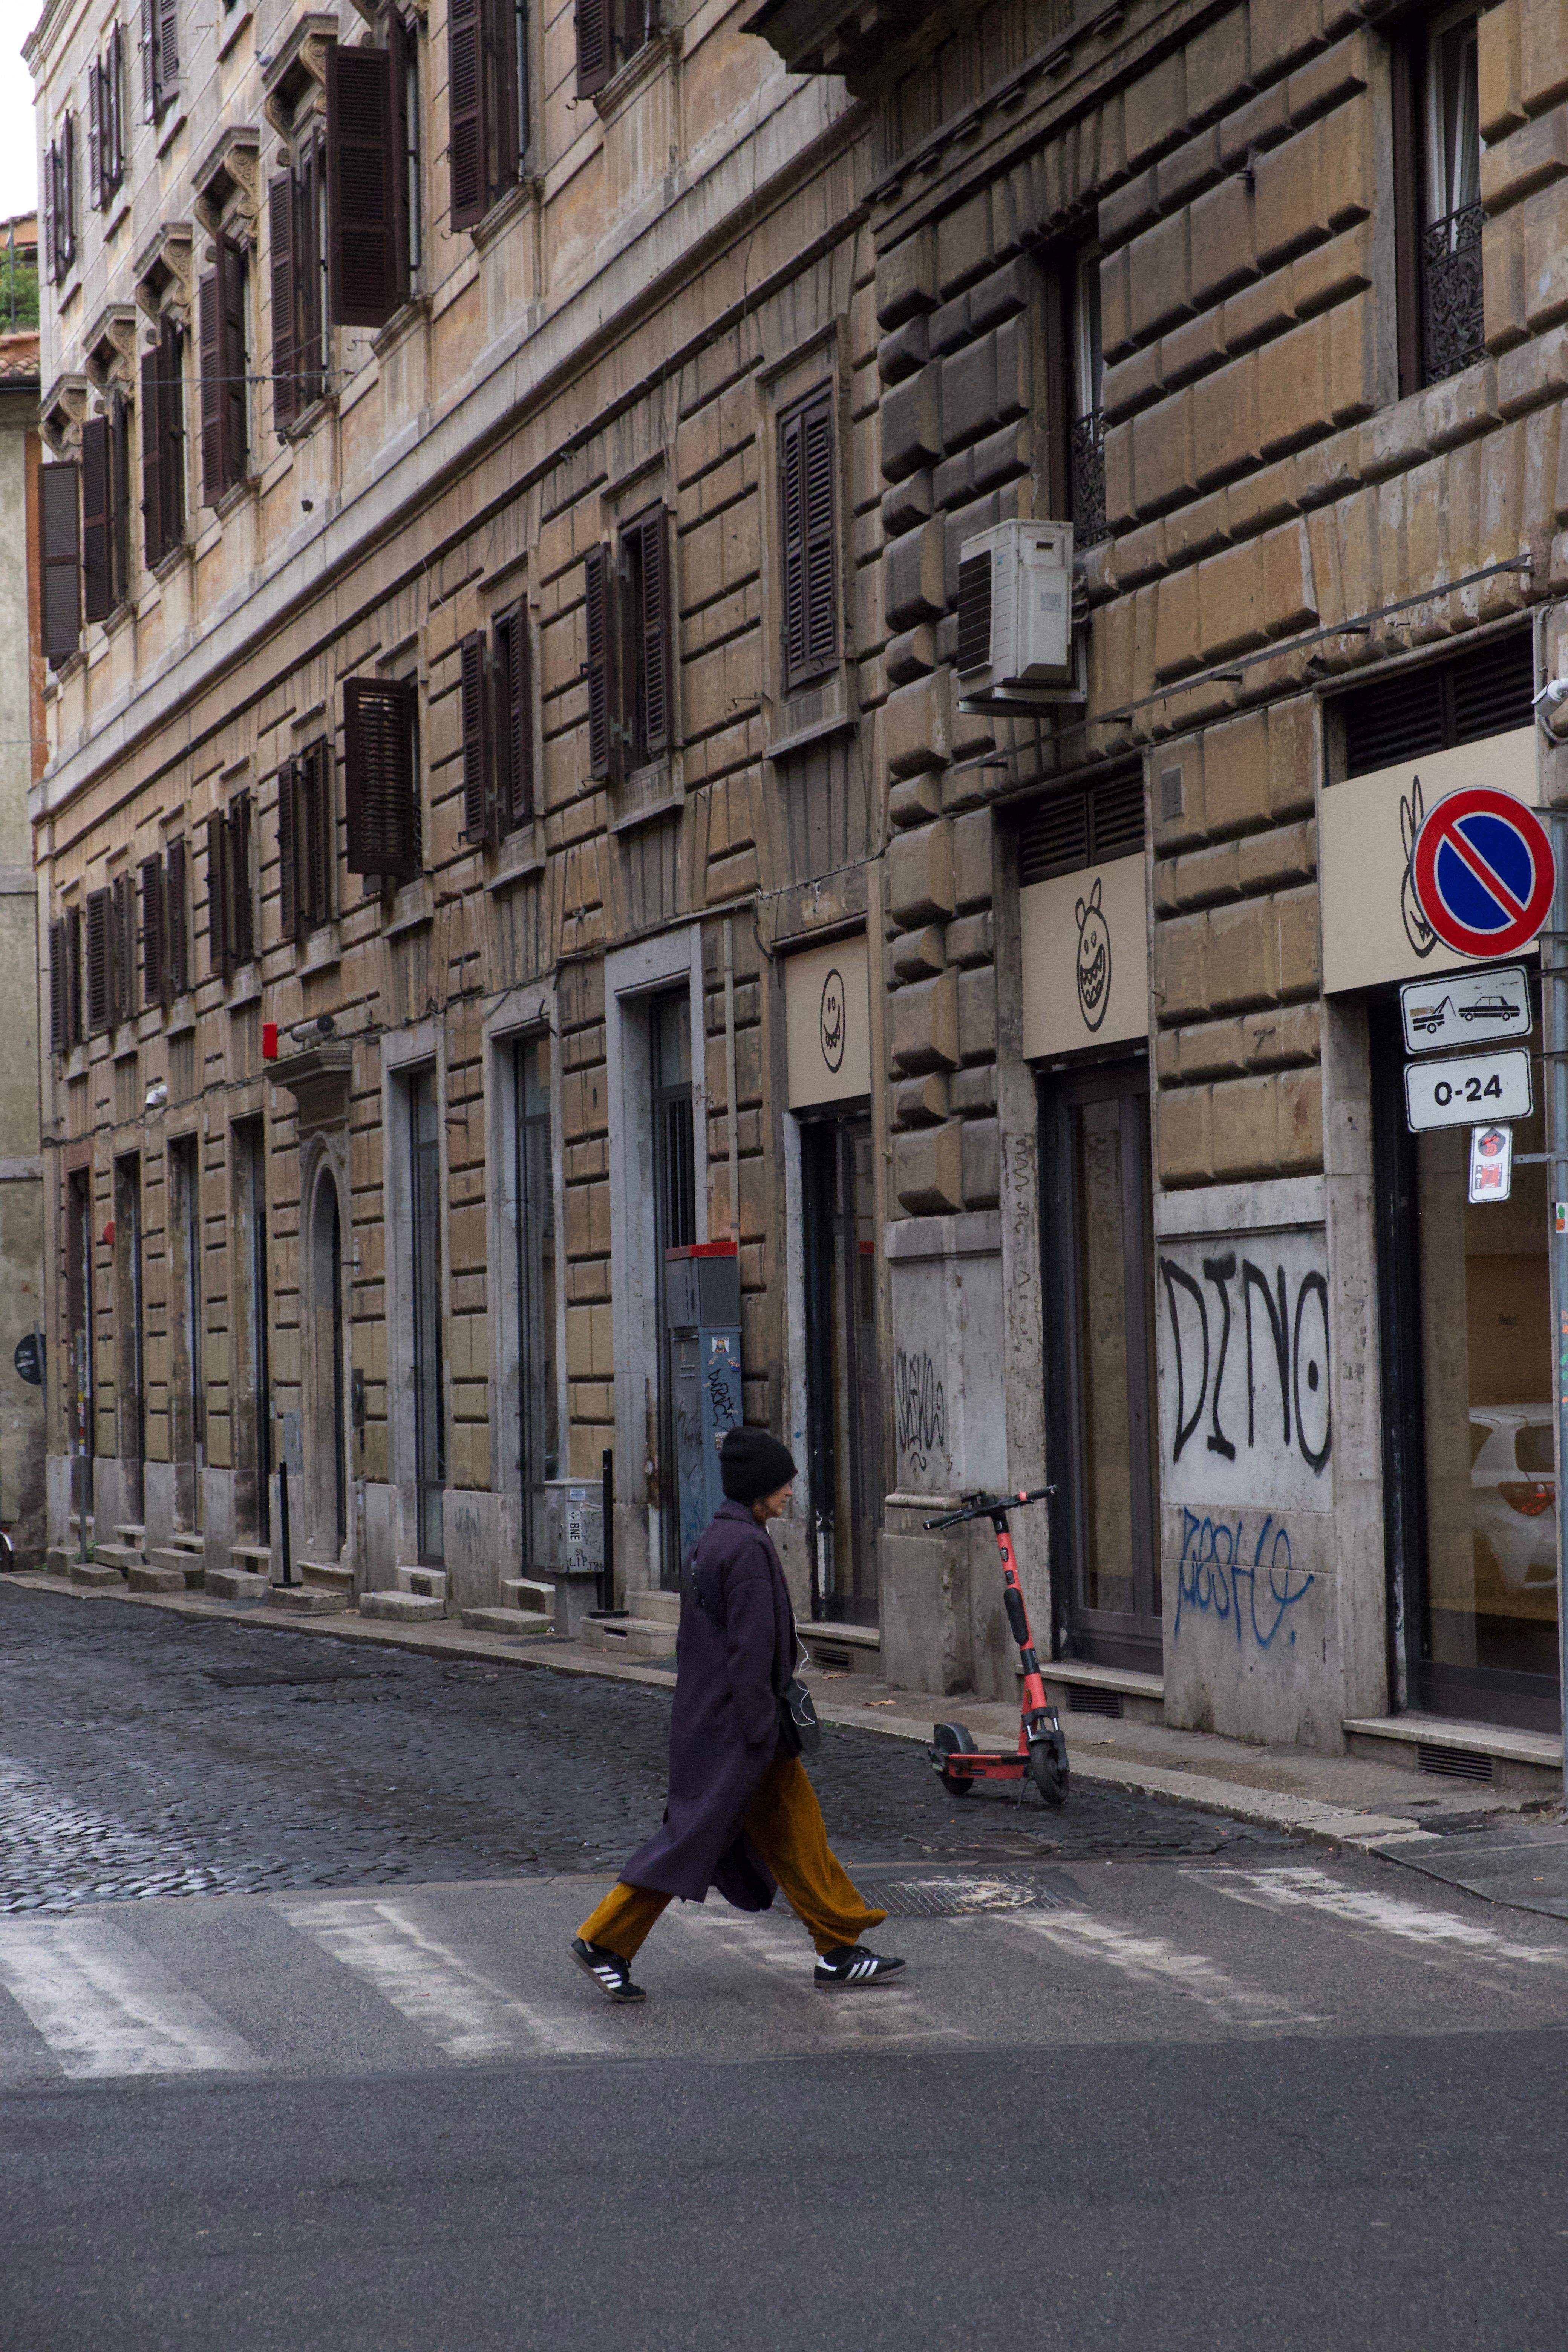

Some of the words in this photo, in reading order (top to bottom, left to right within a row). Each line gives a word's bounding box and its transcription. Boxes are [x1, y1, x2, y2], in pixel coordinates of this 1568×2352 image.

[1434, 1075, 1503, 1106] 0-24
[1159, 1252, 1332, 1475] DINO
[570, 1523, 580, 1540] BNE
